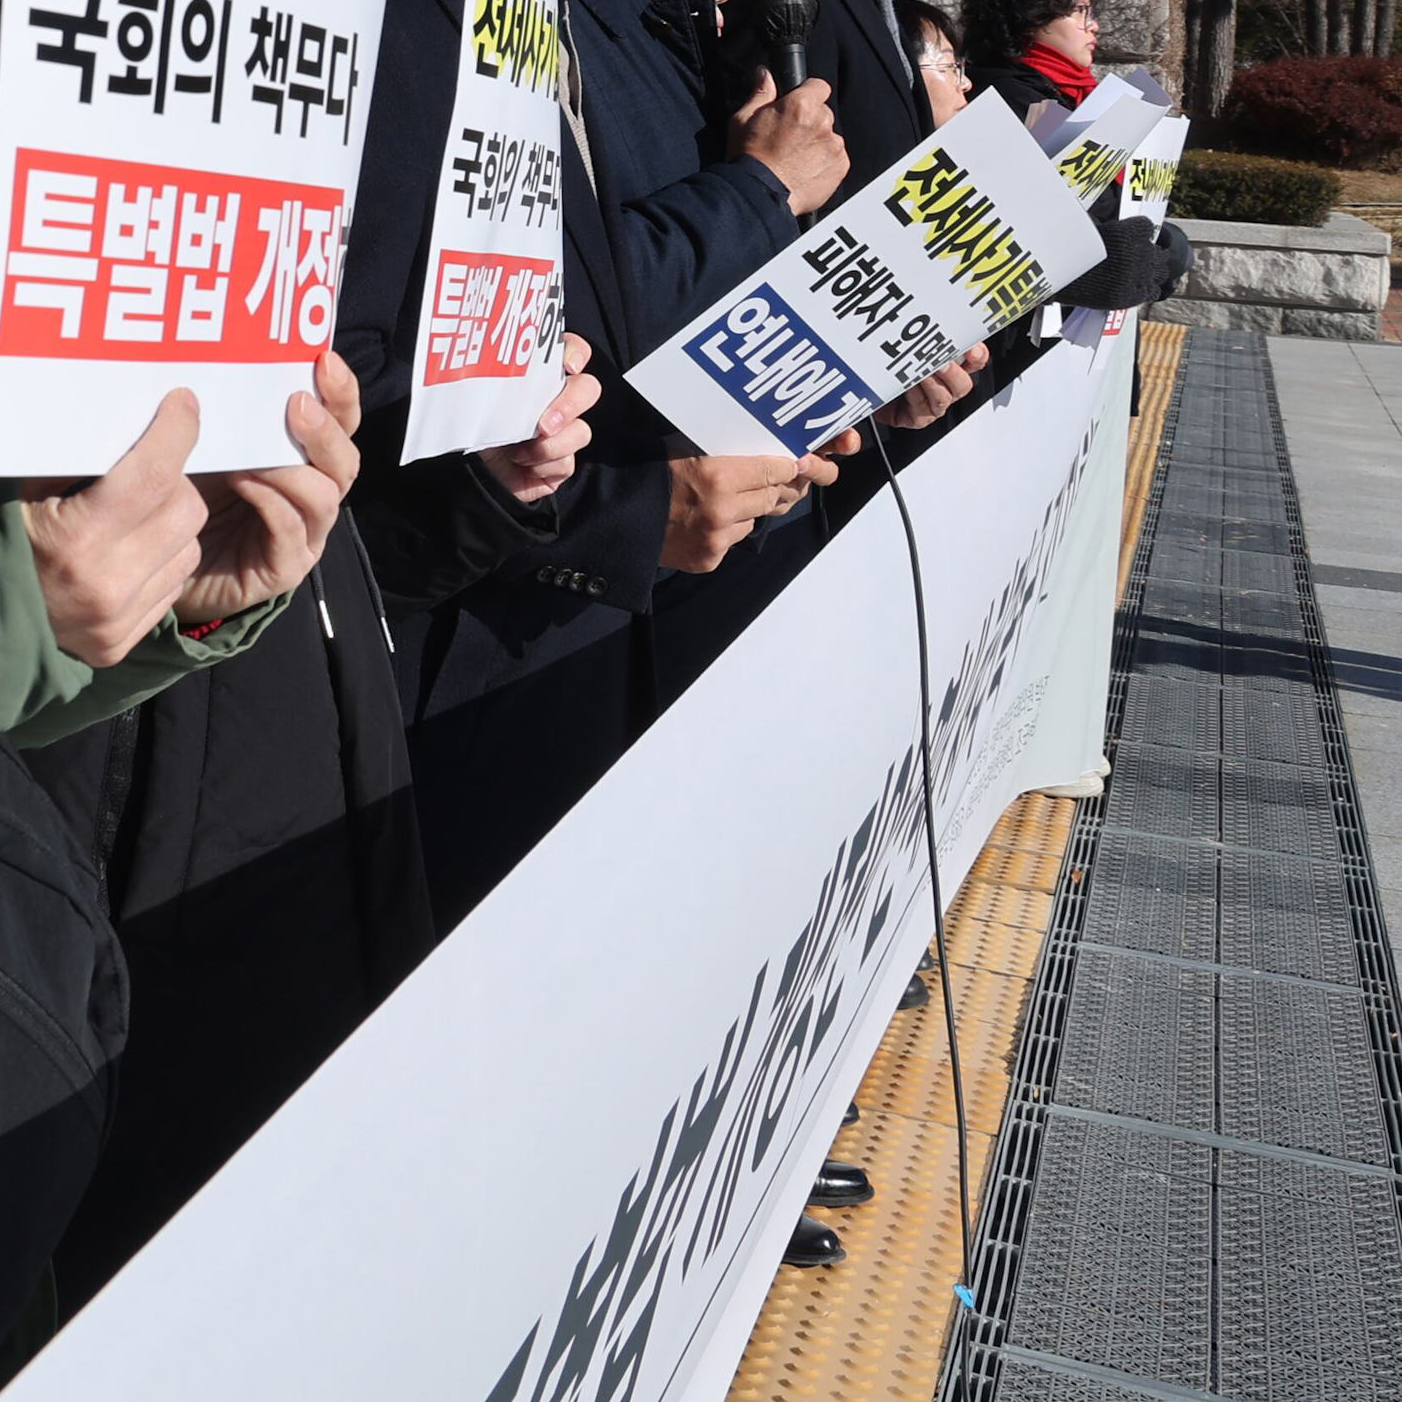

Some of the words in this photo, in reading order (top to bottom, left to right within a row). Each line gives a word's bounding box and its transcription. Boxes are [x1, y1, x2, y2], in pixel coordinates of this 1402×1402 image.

[245, 6, 359, 146] 책무다
[452, 128, 525, 222] 국회의
[7, 169, 241, 343] 특별법
[430, 263, 502, 372] 특별법
[802, 226, 914, 342] 피해자
[700, 296, 847, 428] 연내에
